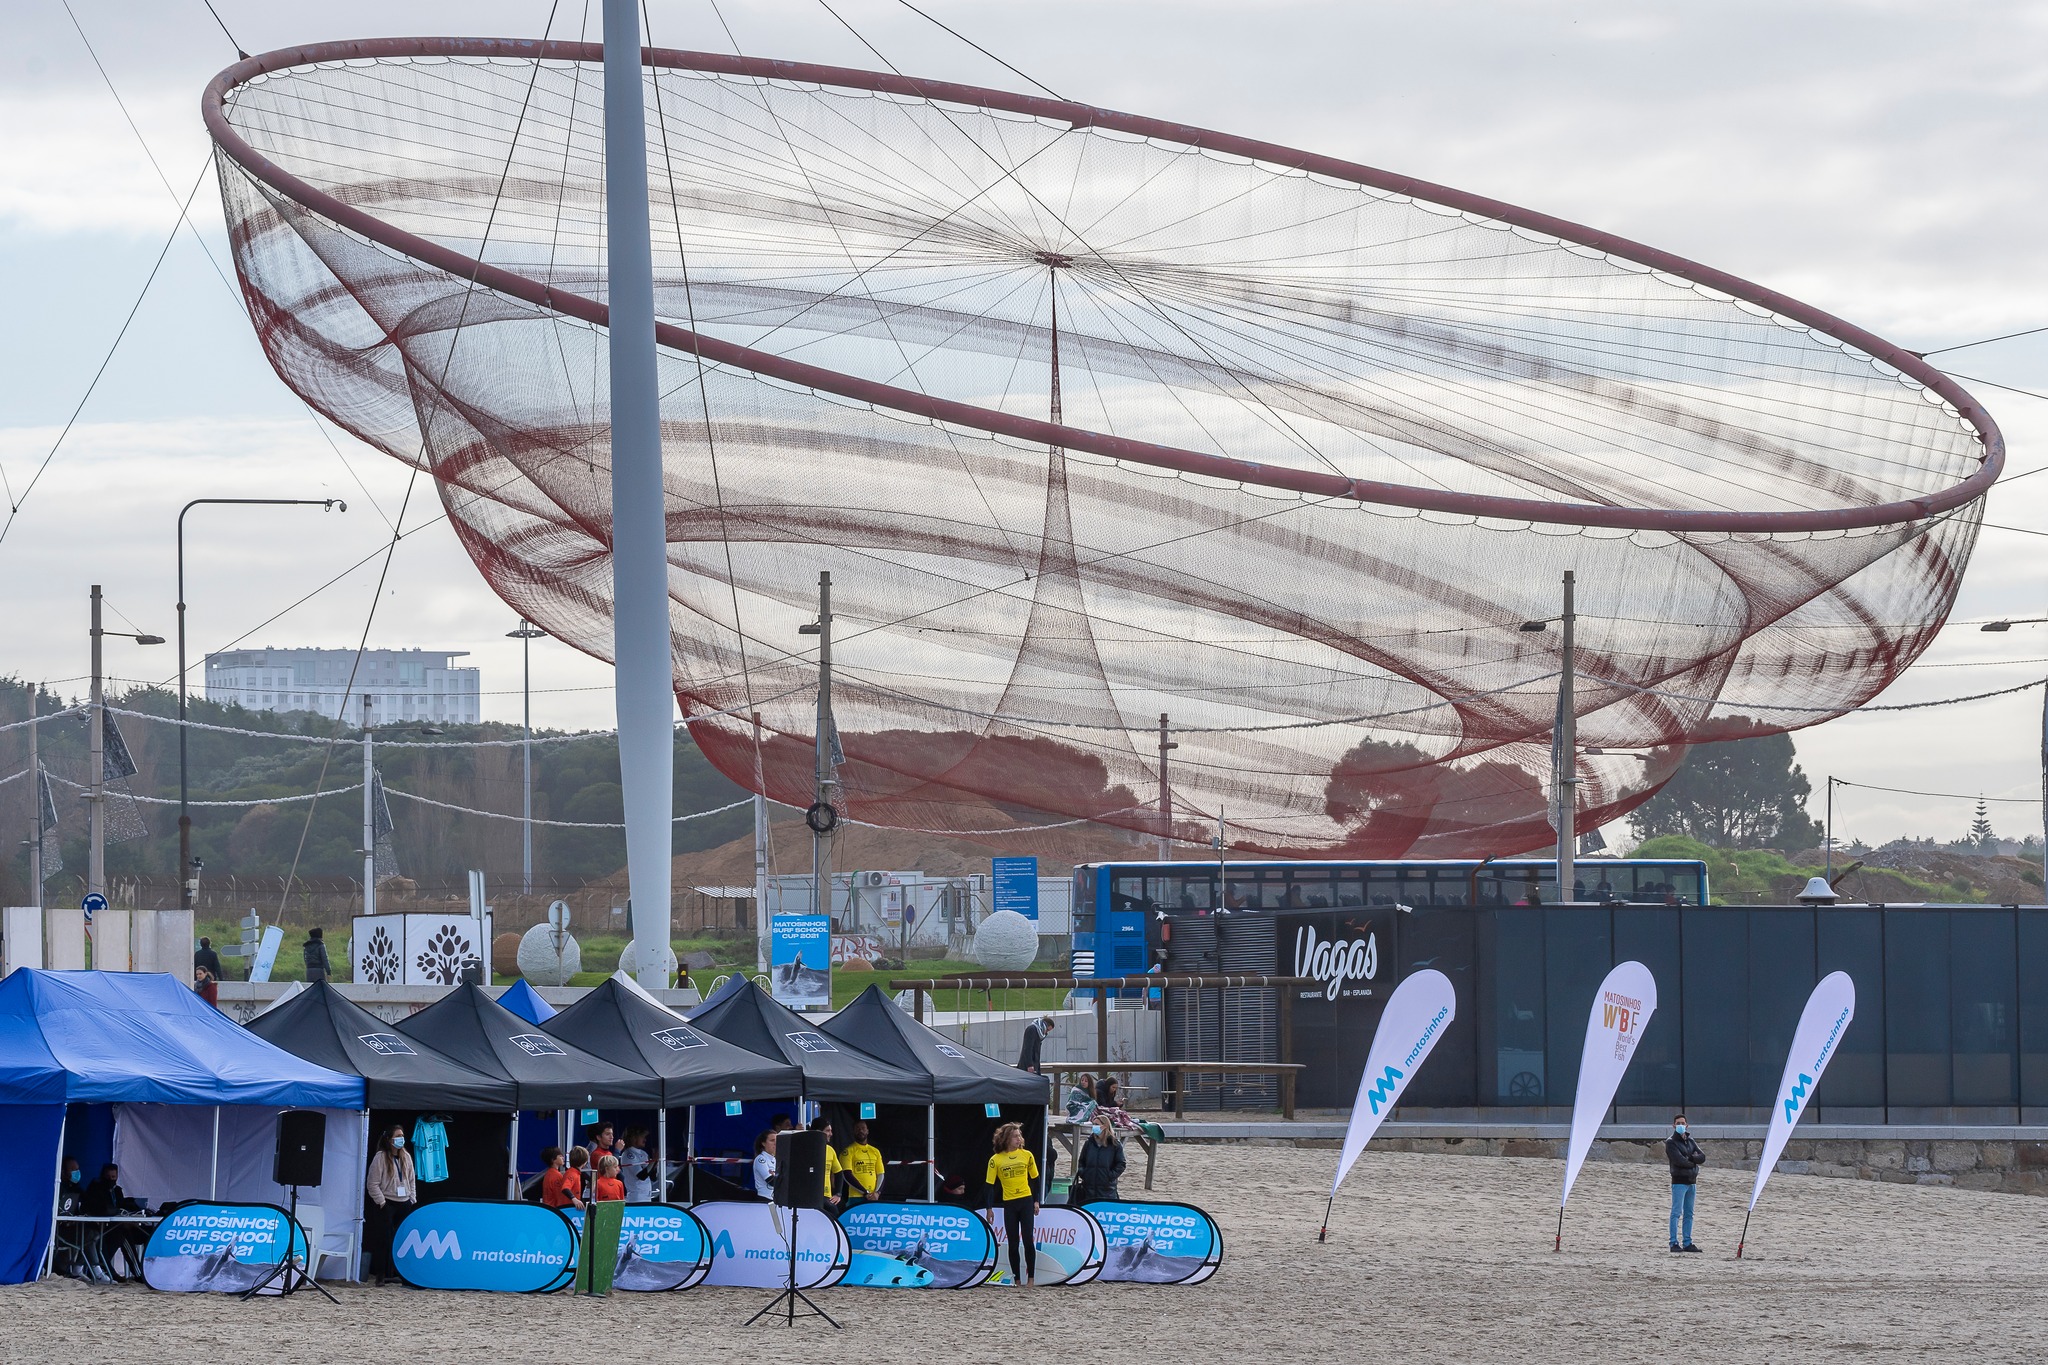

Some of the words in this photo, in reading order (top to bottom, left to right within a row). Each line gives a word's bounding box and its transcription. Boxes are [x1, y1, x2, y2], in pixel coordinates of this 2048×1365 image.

[1295, 925, 1377, 1001] Vagas
[1604, 991, 1642, 1010] MATOSINHOS
[1404, 1006, 1448, 1067] matosinhos
[1618, 1032, 1635, 1045] World's
[1814, 1006, 1849, 1072] matosinhos
[1616, 1041, 1627, 1052] Best
[1614, 1050, 1625, 1061] Fish
[172, 1216, 280, 1230] MATOSINHOS
[850, 1213, 970, 1228] MATOSINHOS
[1093, 1212, 1196, 1227] ATOSINHOS
[165, 1229, 208, 1241] SURF
[209, 1230, 276, 1244] SCHOOL
[619, 1230, 684, 1242] CHOOL
[847, 1226, 892, 1237] SURF
[895, 1228, 971, 1241] SCHOOL
[1122, 1225, 1196, 1239] SCHOOL
[179, 1243, 213, 1255] CUP
[863, 1239, 902, 1250] CUP
[1106, 1237, 1129, 1247] UP
[472, 1248, 564, 1265] matosinhos
[745, 1248, 831, 1263] matosnhos
